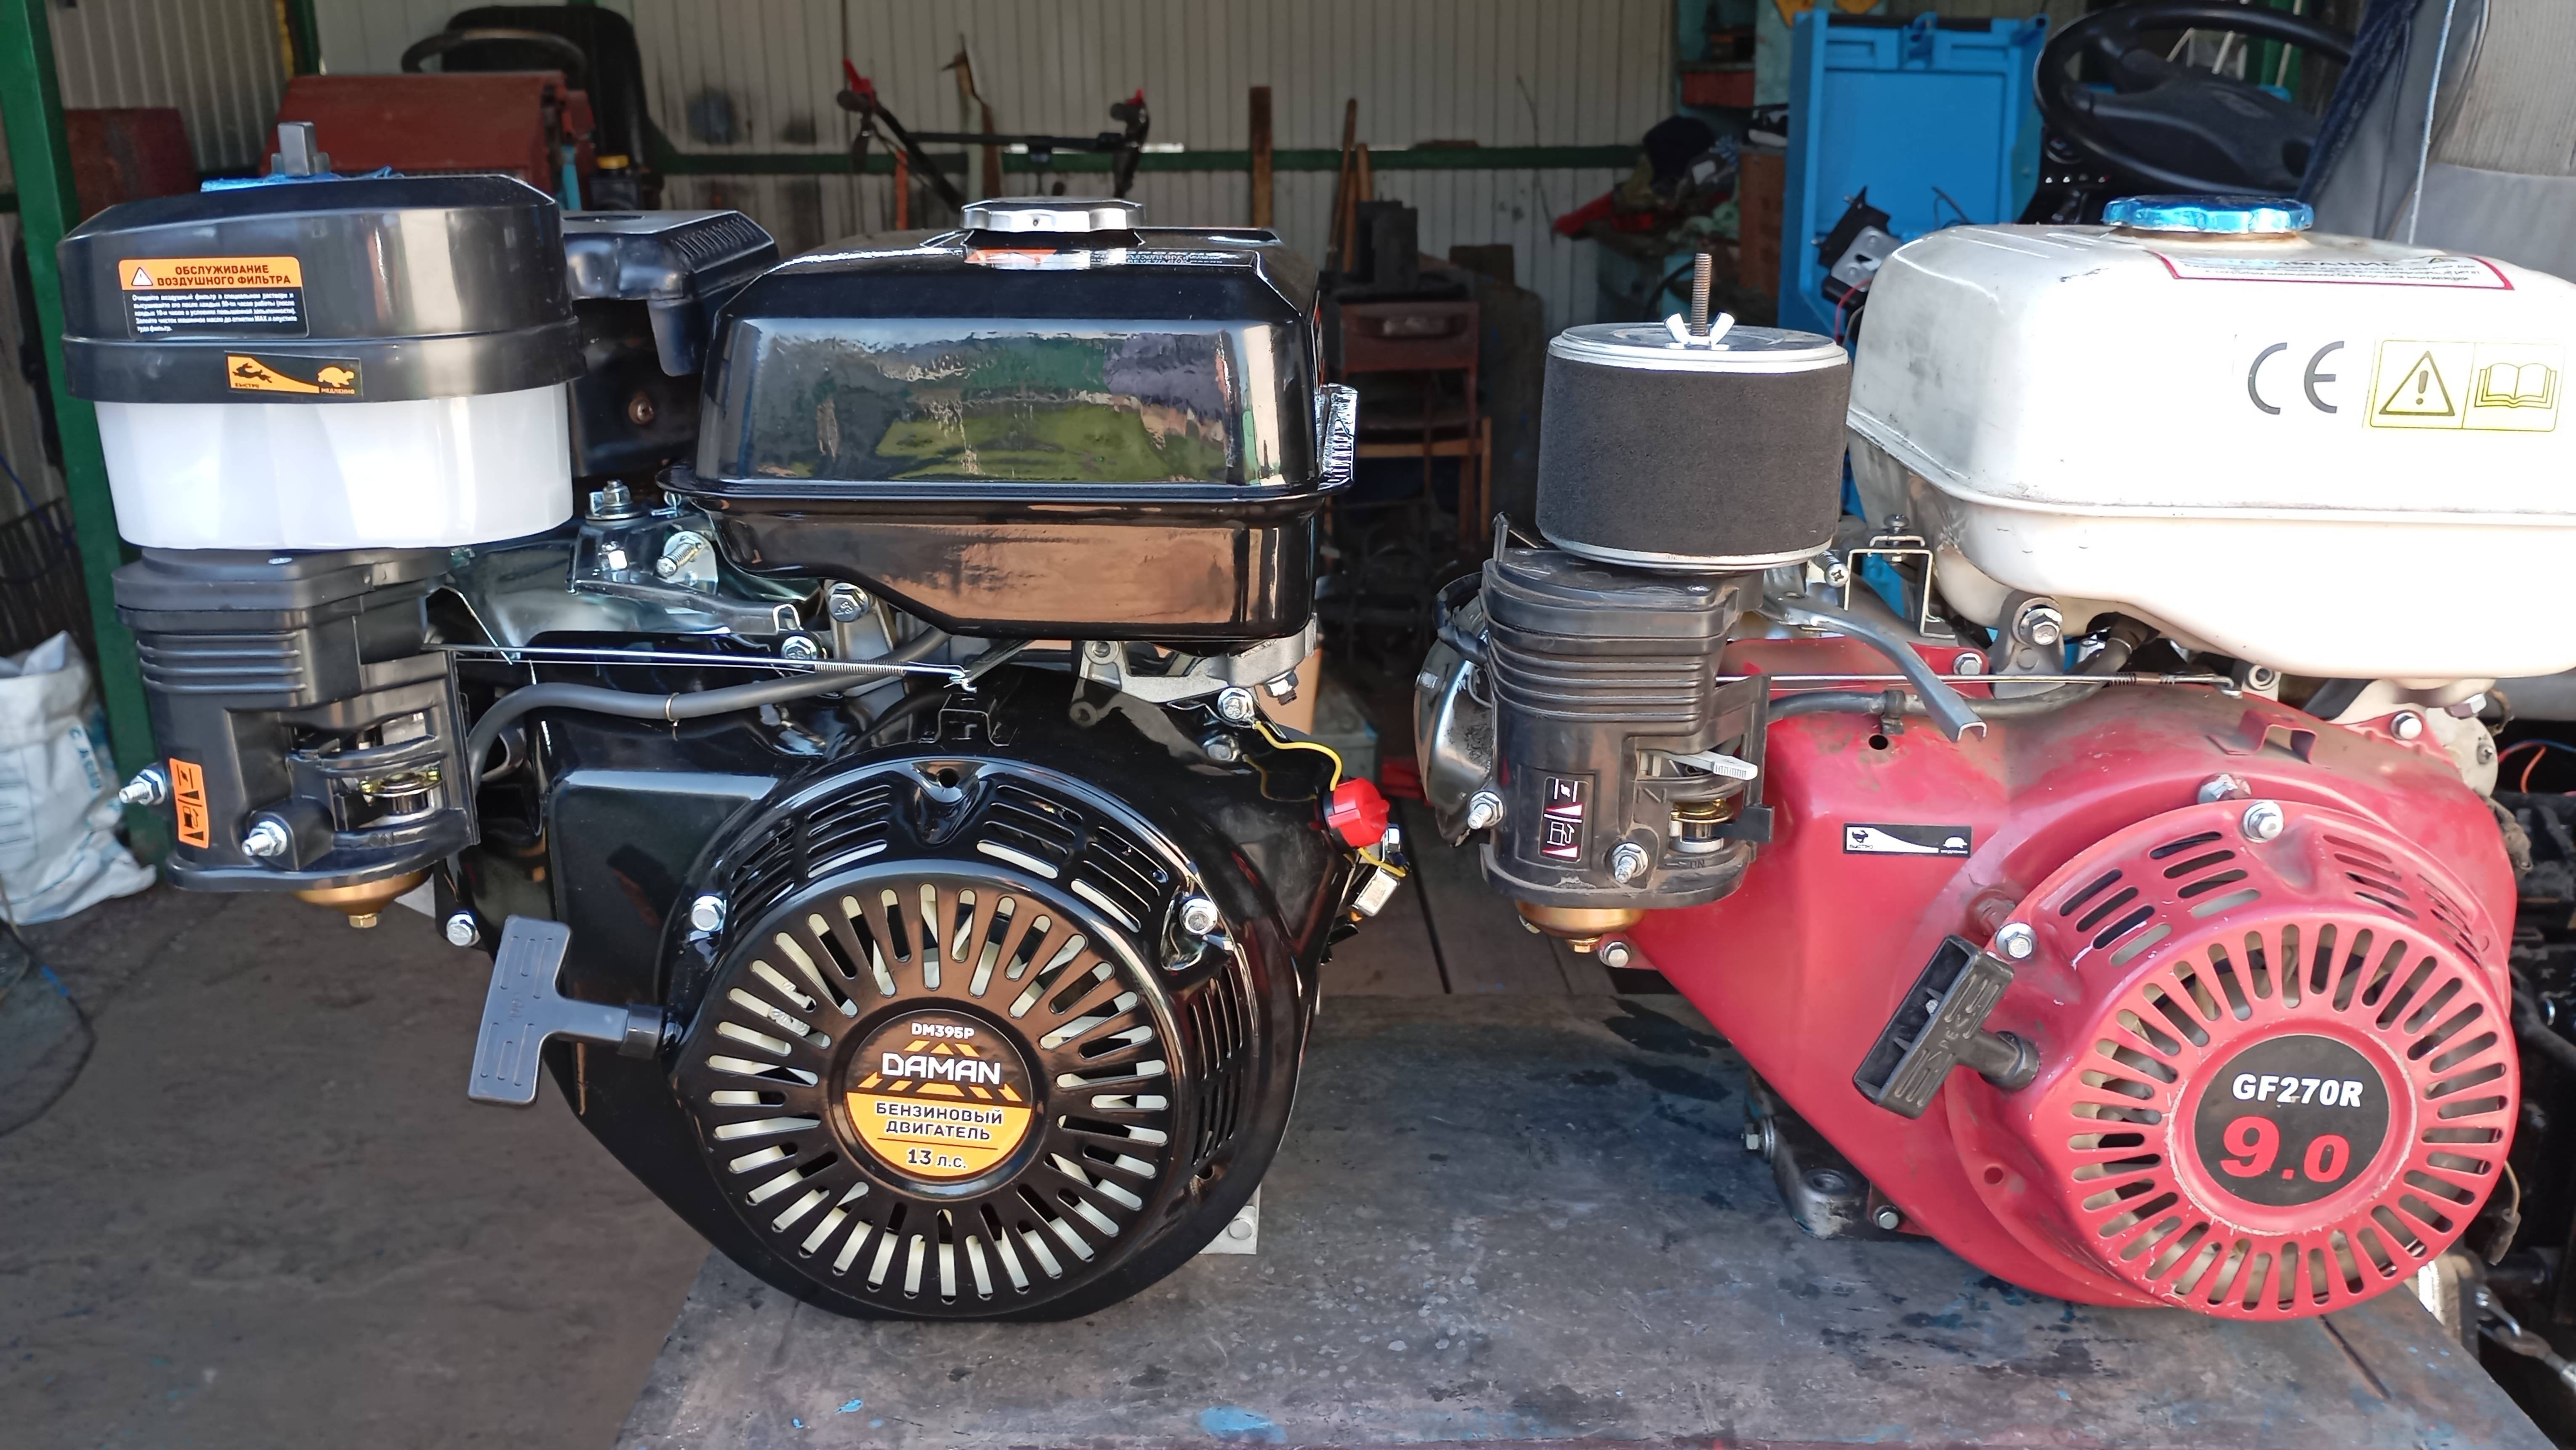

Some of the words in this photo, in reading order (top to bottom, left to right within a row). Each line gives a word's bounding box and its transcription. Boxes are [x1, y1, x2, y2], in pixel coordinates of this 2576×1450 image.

[175, 265, 269, 275] ОБСЛУЖИВАНИЕ
[157, 276, 234, 287] ВОЗДУШНОГО
[237, 275, 291, 285] ФИЛЬТРА
[2247, 341, 2344, 415] CE
[367, 831, 395, 848] ON
[911, 1023, 975, 1039] DM395P
[882, 1053, 1001, 1085] DAMAN
[2232, 1073, 2364, 1107] GF270R
[876, 1103, 1003, 1125] БЕНЗИНОВЫЙ
[886, 1121, 990, 1141] ДВИГАТЕЛЬ
[907, 1149, 932, 1165] 13
[2219, 1116, 2350, 1183] 9.0
